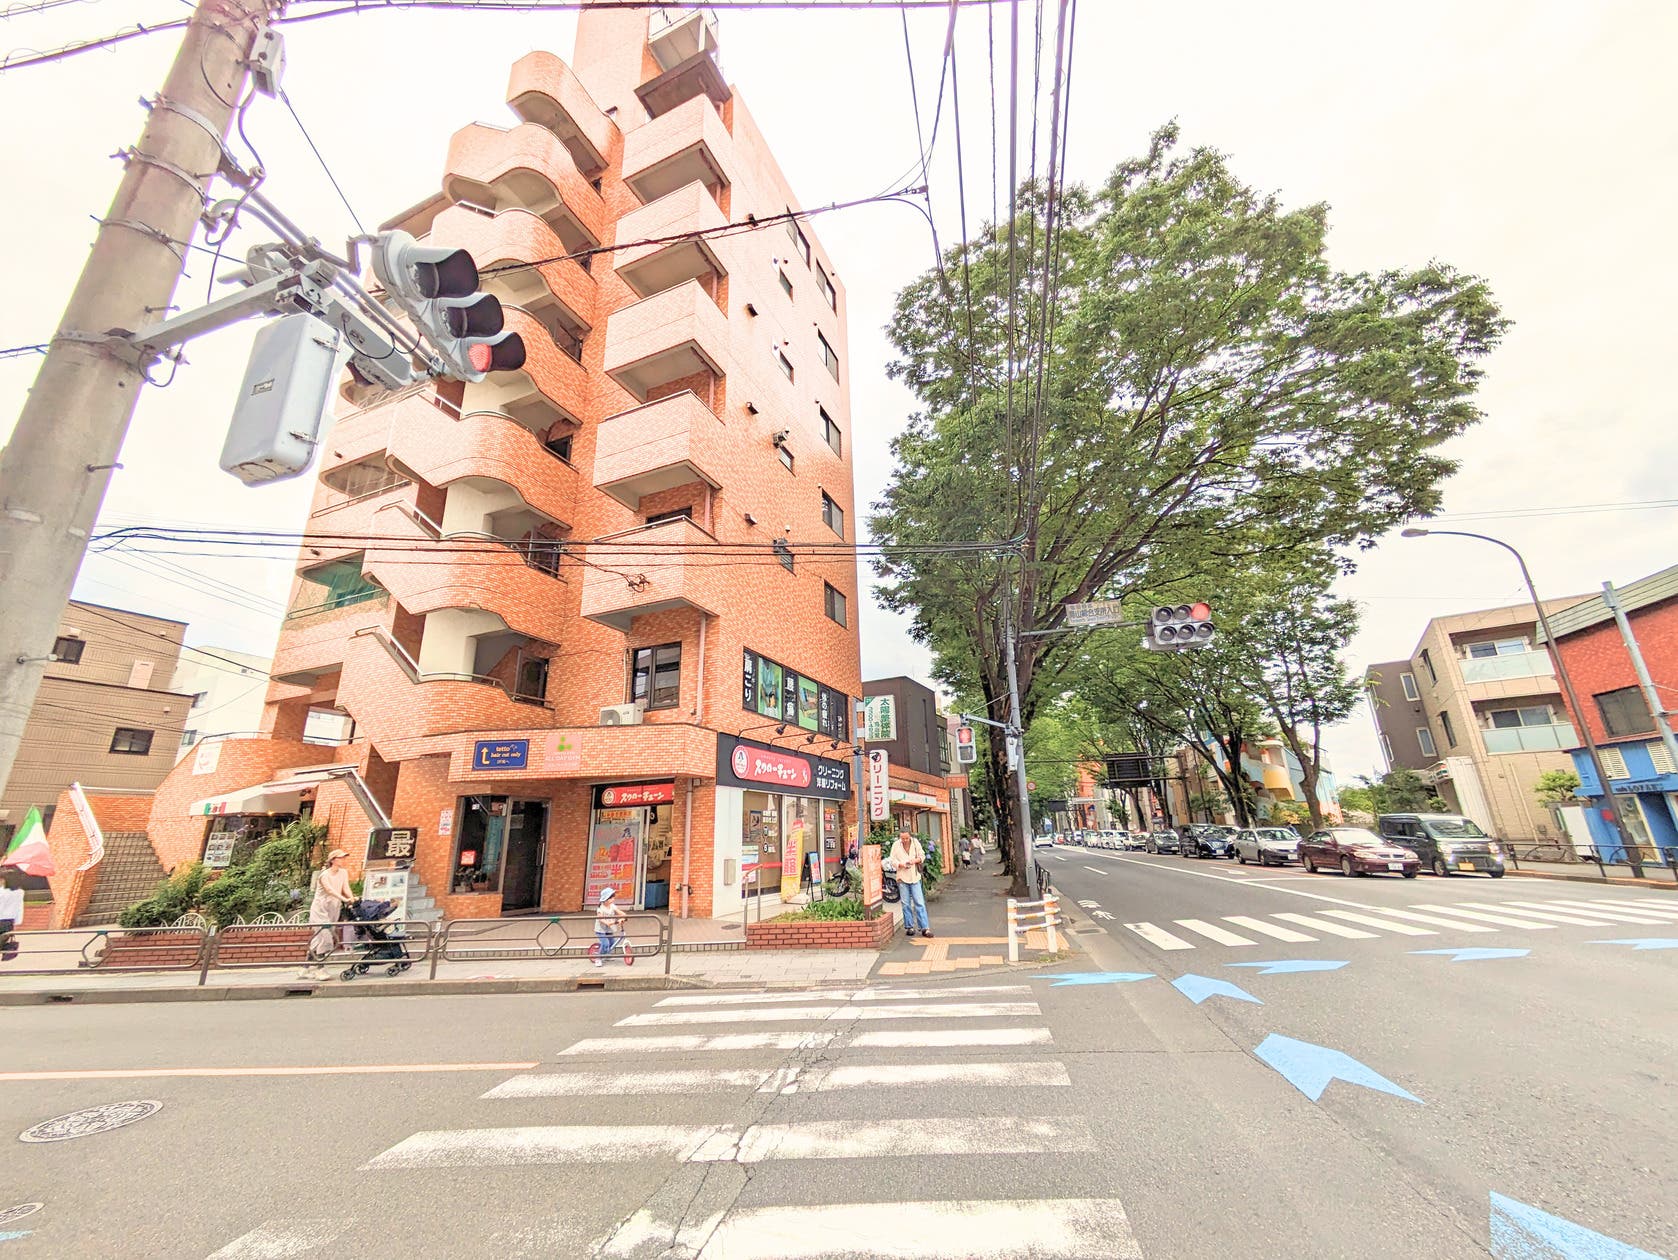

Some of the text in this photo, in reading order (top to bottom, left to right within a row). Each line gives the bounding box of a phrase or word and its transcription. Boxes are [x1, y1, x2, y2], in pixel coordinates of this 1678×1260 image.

[818, 765, 844, 779] クリーニング
[816, 777, 846, 791] 洋服リフォーム
[385, 831, 414, 857] 最
